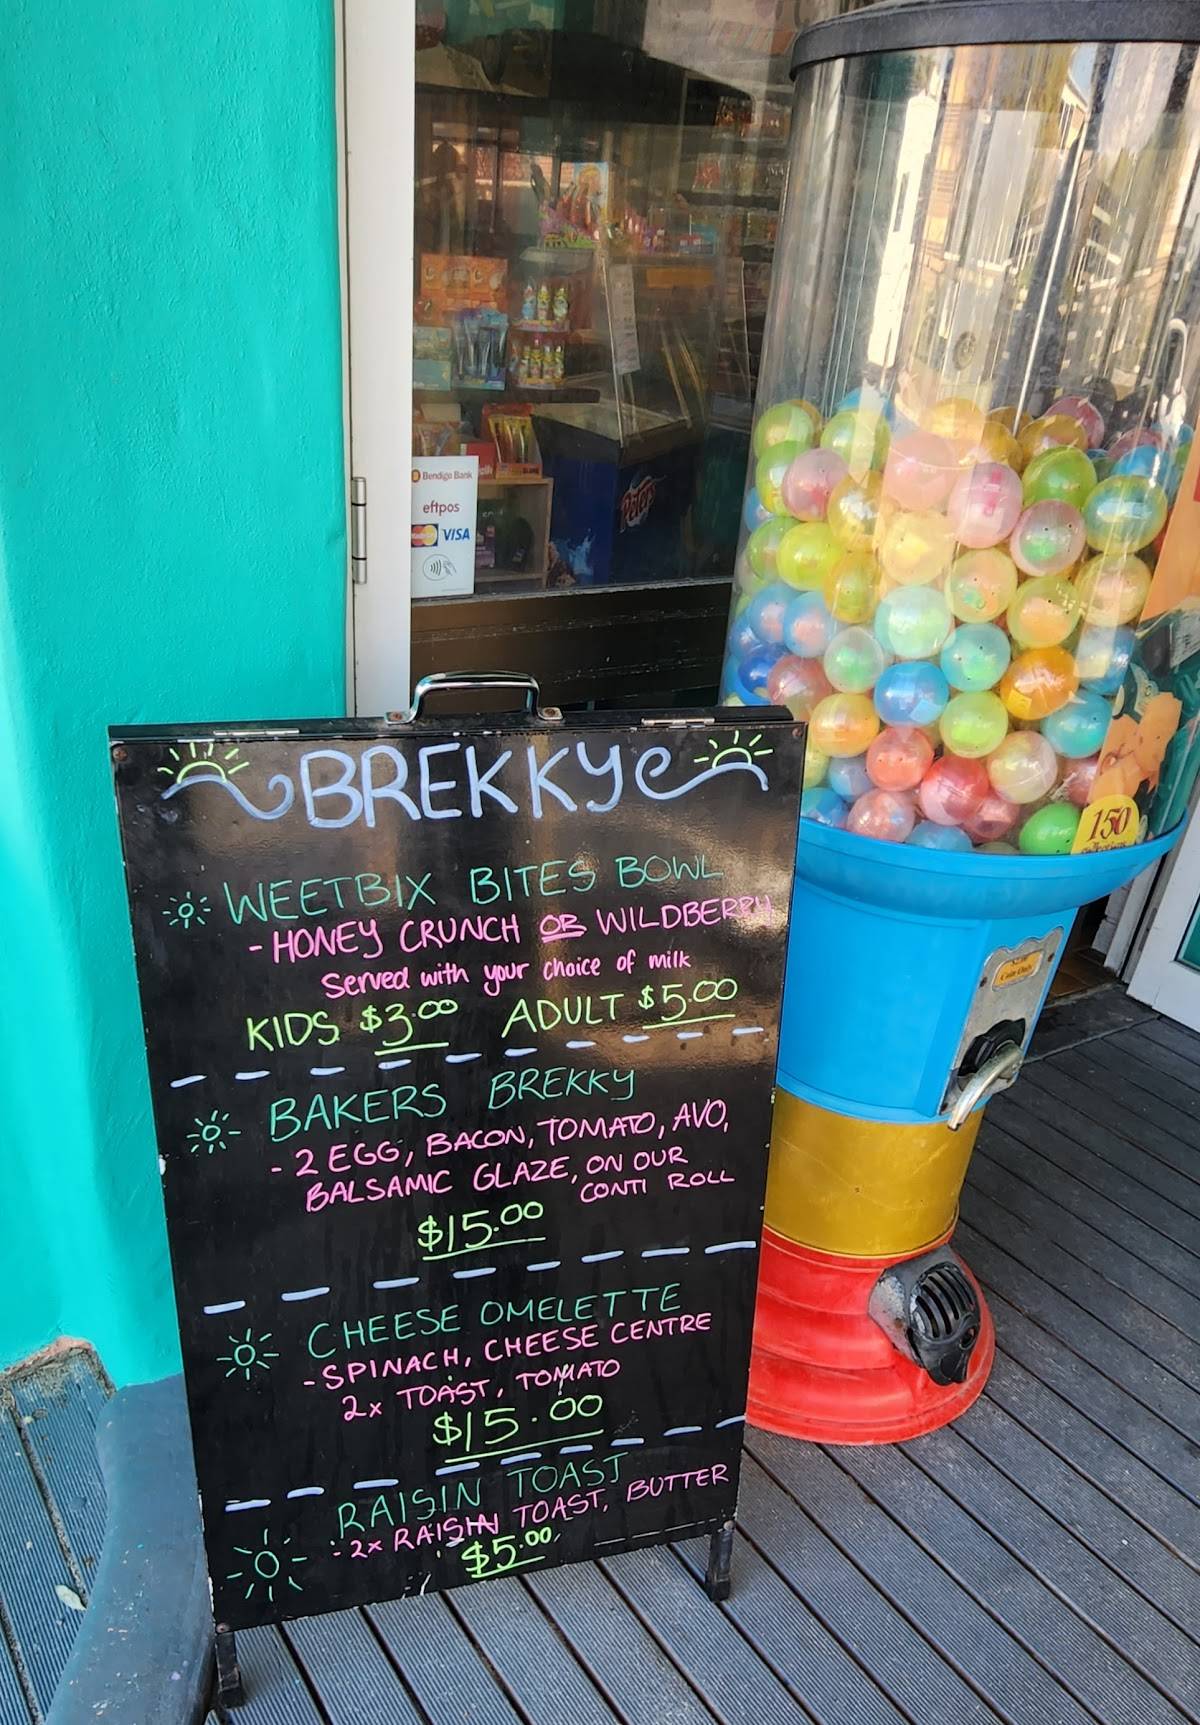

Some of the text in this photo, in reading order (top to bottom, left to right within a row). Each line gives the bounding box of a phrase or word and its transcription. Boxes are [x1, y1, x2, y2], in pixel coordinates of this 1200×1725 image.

[422, 471, 473, 481] Bendigo Bank
[423, 500, 460, 516] eftpos
[442, 528, 470, 541] VISA
[300, 742, 622, 829] BREKKY
[1087, 806, 1132, 842] 150
[223, 855, 724, 925] WEETBIX BITES BOWL
[400, 913, 521, 950] CRUNCH
[539, 914, 587, 944] OR
[596, 894, 774, 936] WILDBERRY
[321, 949, 692, 999] Served with your choice of milk
[246, 977, 739, 1051] KIDS $3.00 ADULT $5.00
[269, 1066, 635, 1142] BAKERS BREKKY
[295, 1148, 319, 1177] 2
[305, 1169, 453, 1212] BALSAMIC
[586, 1153, 623, 1175] ON
[633, 1146, 689, 1171] OUR
[579, 1170, 736, 1203] CONTI ROLL
[417, 1200, 545, 1252] $15.00
[307, 1282, 681, 1360] CHEESE OMELETTE
[484, 1324, 599, 1362] CHEESE
[610, 1312, 713, 1344] CENTRE
[515, 1358, 621, 1391] TOMATO
[432, 1394, 603, 1452] $15.00
[337, 1451, 629, 1539] RAISIN TOAST
[626, 1463, 730, 1502] BUTTER
[460, 1526, 553, 1576] $5.00
